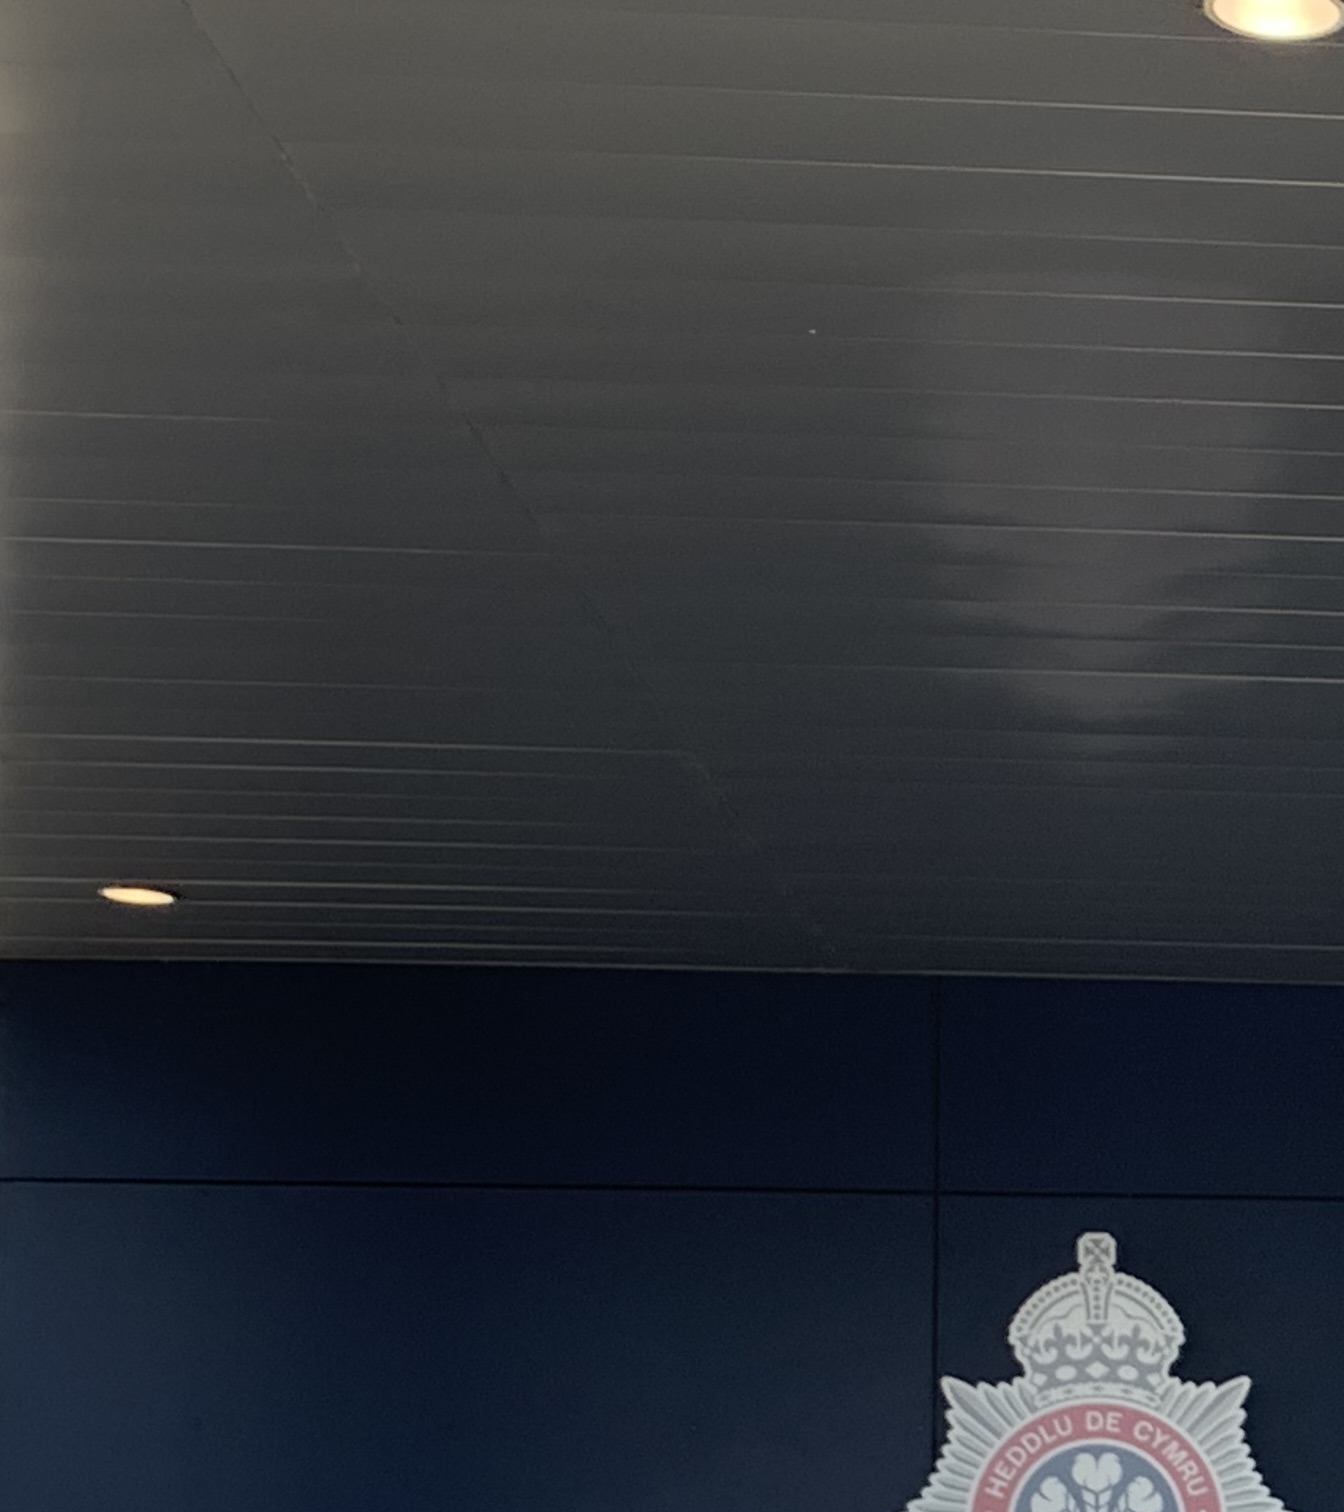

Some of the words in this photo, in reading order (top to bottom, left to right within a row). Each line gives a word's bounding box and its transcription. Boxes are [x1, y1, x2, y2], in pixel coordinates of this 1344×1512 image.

[985, 1413, 1075, 1500] HEDDLU
[1085, 1410, 1122, 1434] DE
[1132, 1419, 1209, 1495] CYMRU
